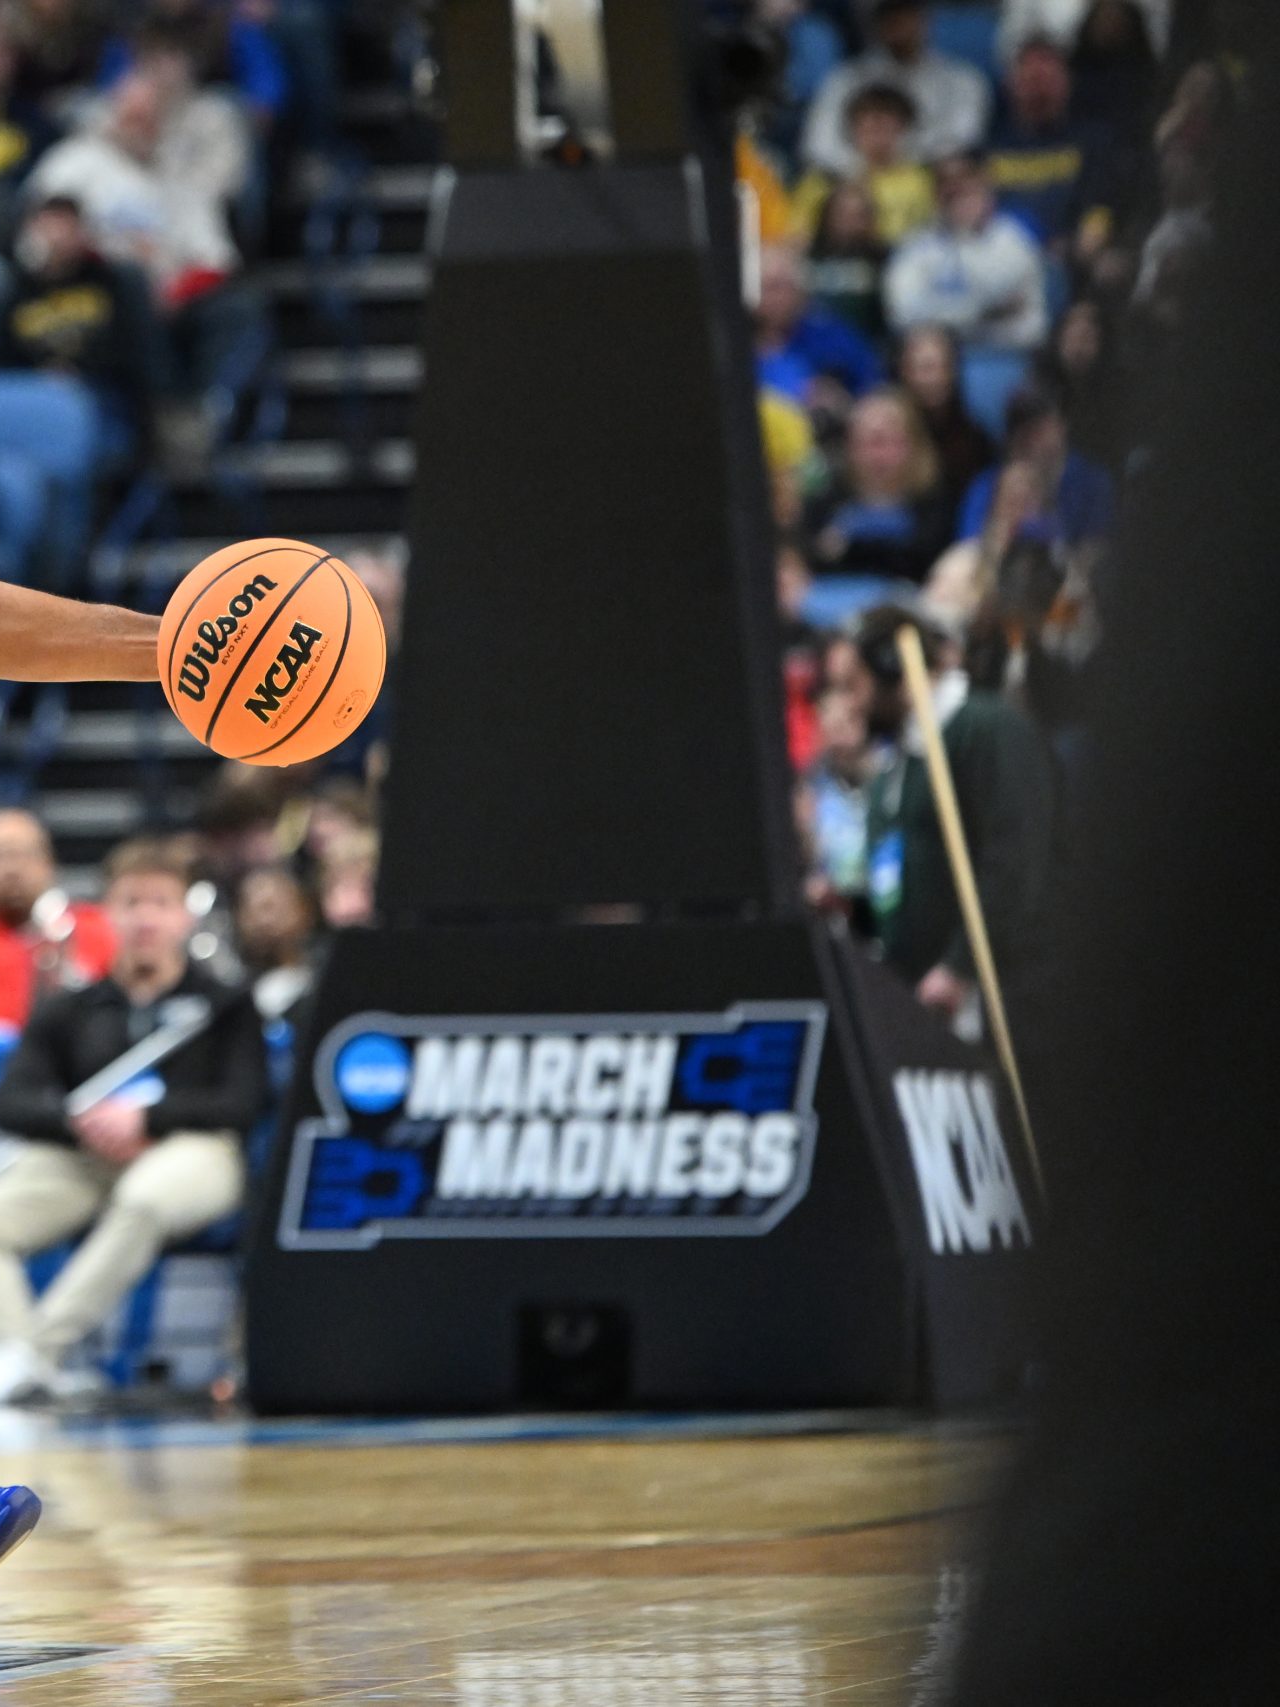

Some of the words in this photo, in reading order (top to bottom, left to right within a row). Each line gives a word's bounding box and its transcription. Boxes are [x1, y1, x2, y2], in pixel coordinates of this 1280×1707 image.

[177, 574, 278, 702] Wilson
[222, 645, 235, 665] EVO
[234, 624, 249, 644] NXT
[244, 620, 323, 724] NCAA
[270, 694, 298, 729] OFFICIAL
[297, 664, 316, 692] GAME
[314, 639, 330, 662] BALL
[407, 1036, 677, 1119] MARCH
[435, 1112, 799, 1199] MADNESS
